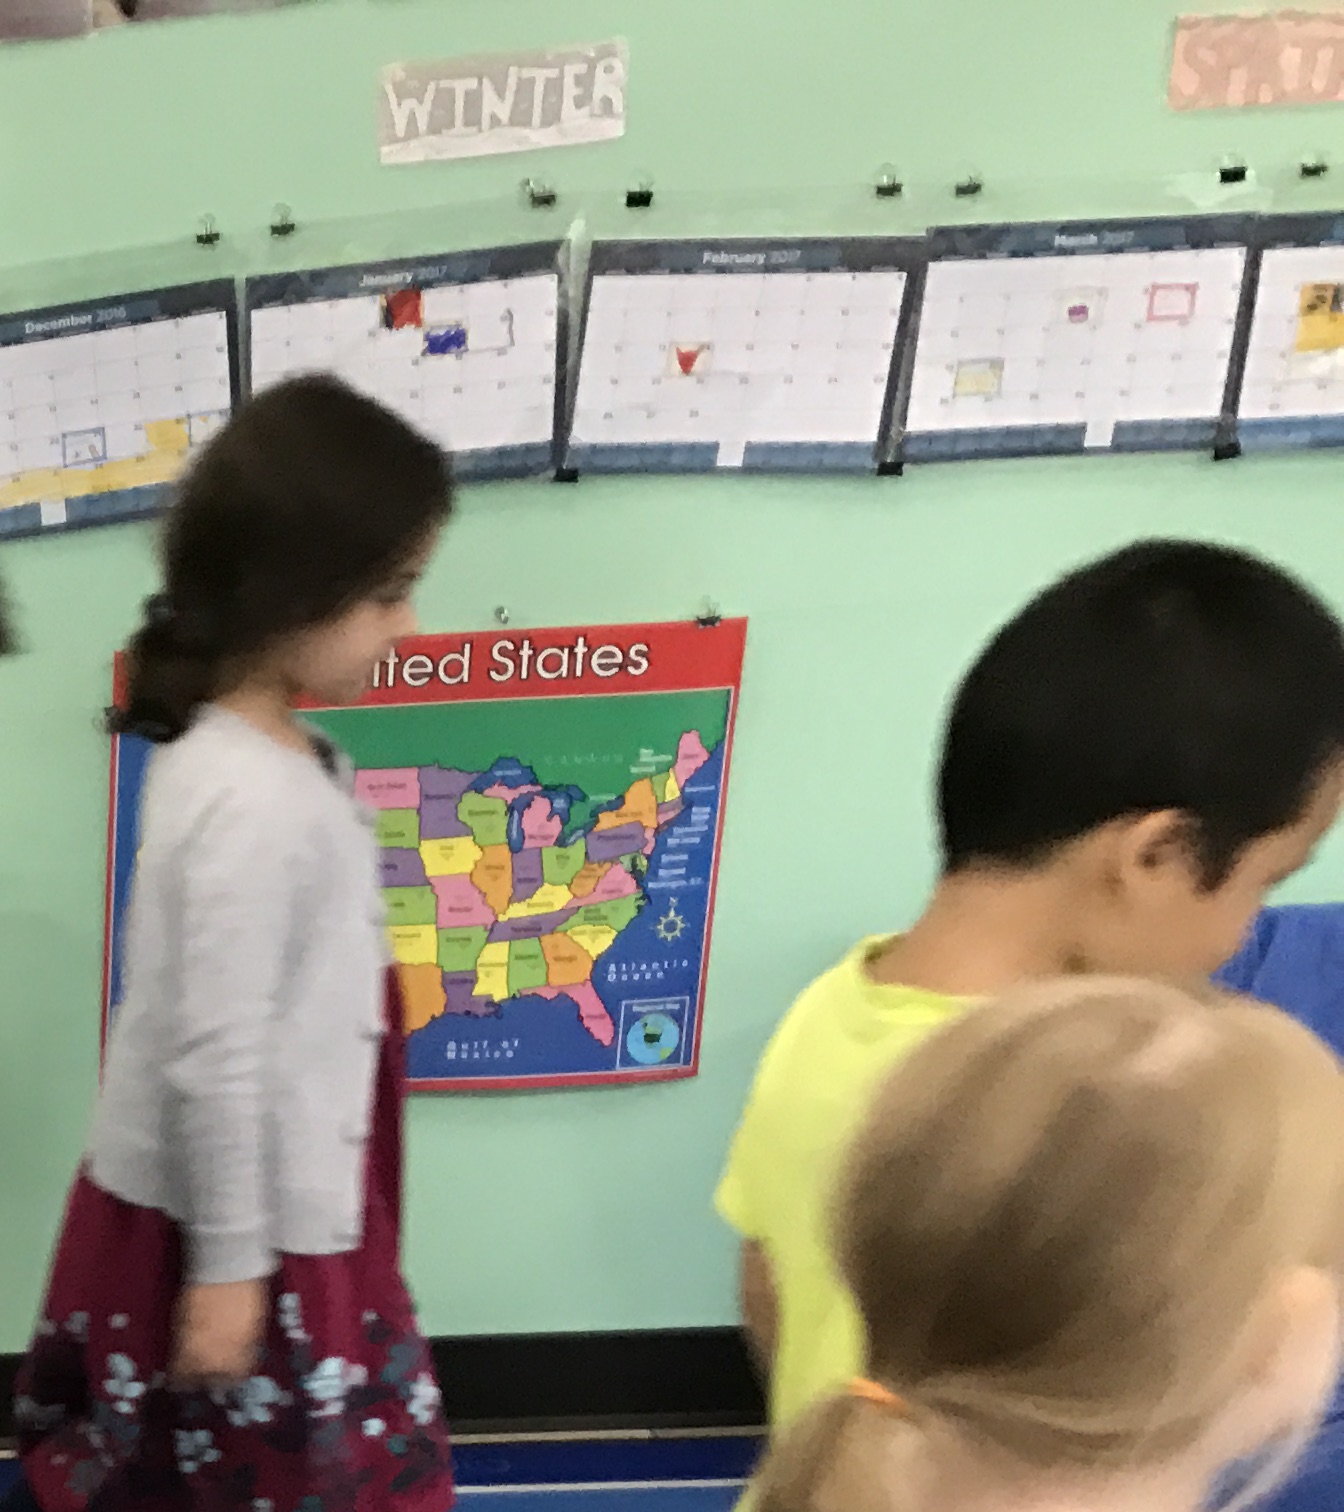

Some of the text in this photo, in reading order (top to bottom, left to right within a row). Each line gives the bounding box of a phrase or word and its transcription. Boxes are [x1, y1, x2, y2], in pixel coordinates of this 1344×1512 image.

[384, 57, 624, 138] WINTER
[703, 251, 766, 265] February
[25, 313, 92, 334] December
[371, 635, 650, 688] ited States
